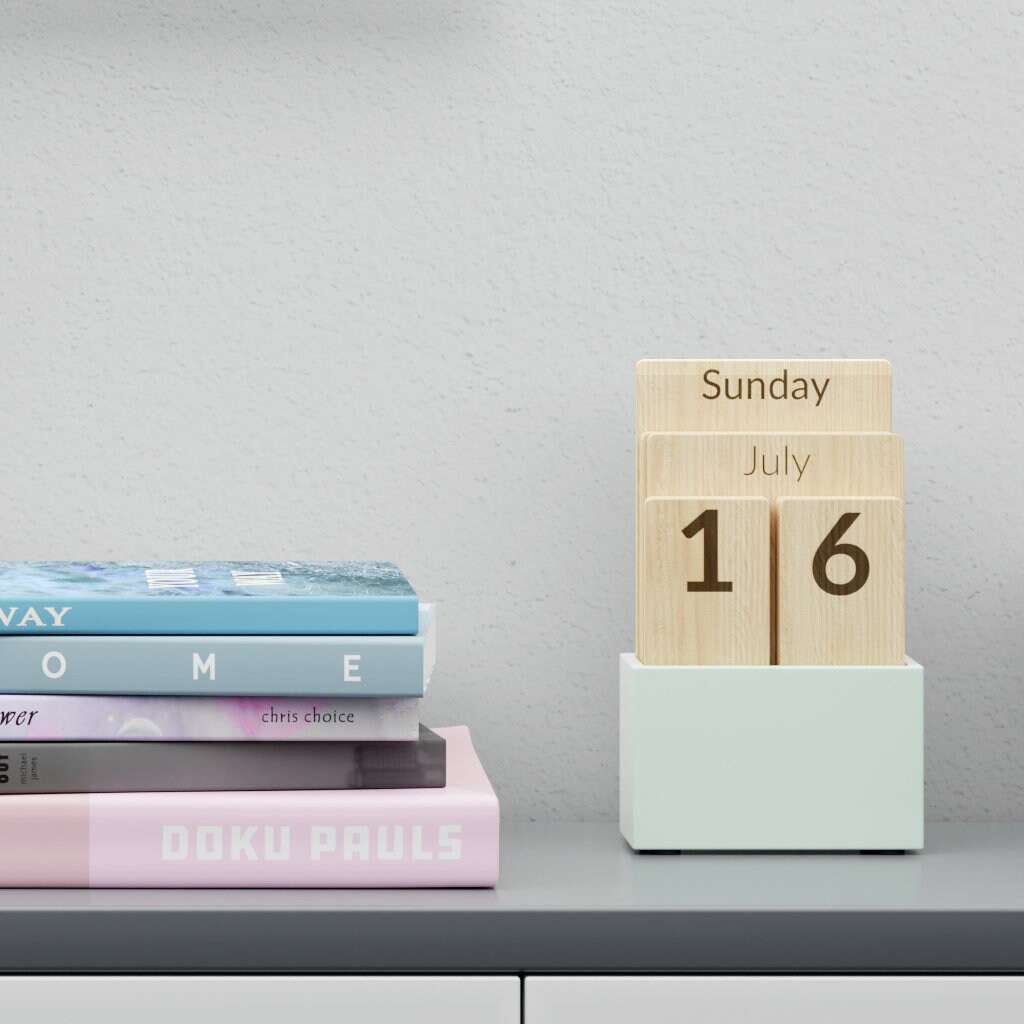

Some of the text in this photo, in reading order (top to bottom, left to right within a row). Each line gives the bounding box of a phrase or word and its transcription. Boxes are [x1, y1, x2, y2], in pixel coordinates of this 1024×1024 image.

[701, 368, 830, 407] Sunday
[743, 444, 811, 483] July
[681, 509, 871, 597] 1 6
[261, 706, 355, 724] chris choice
[18, 752, 27, 785] michael
[31, 756, 39, 781] james
[162, 824, 462, 862] DOKU PAULS
